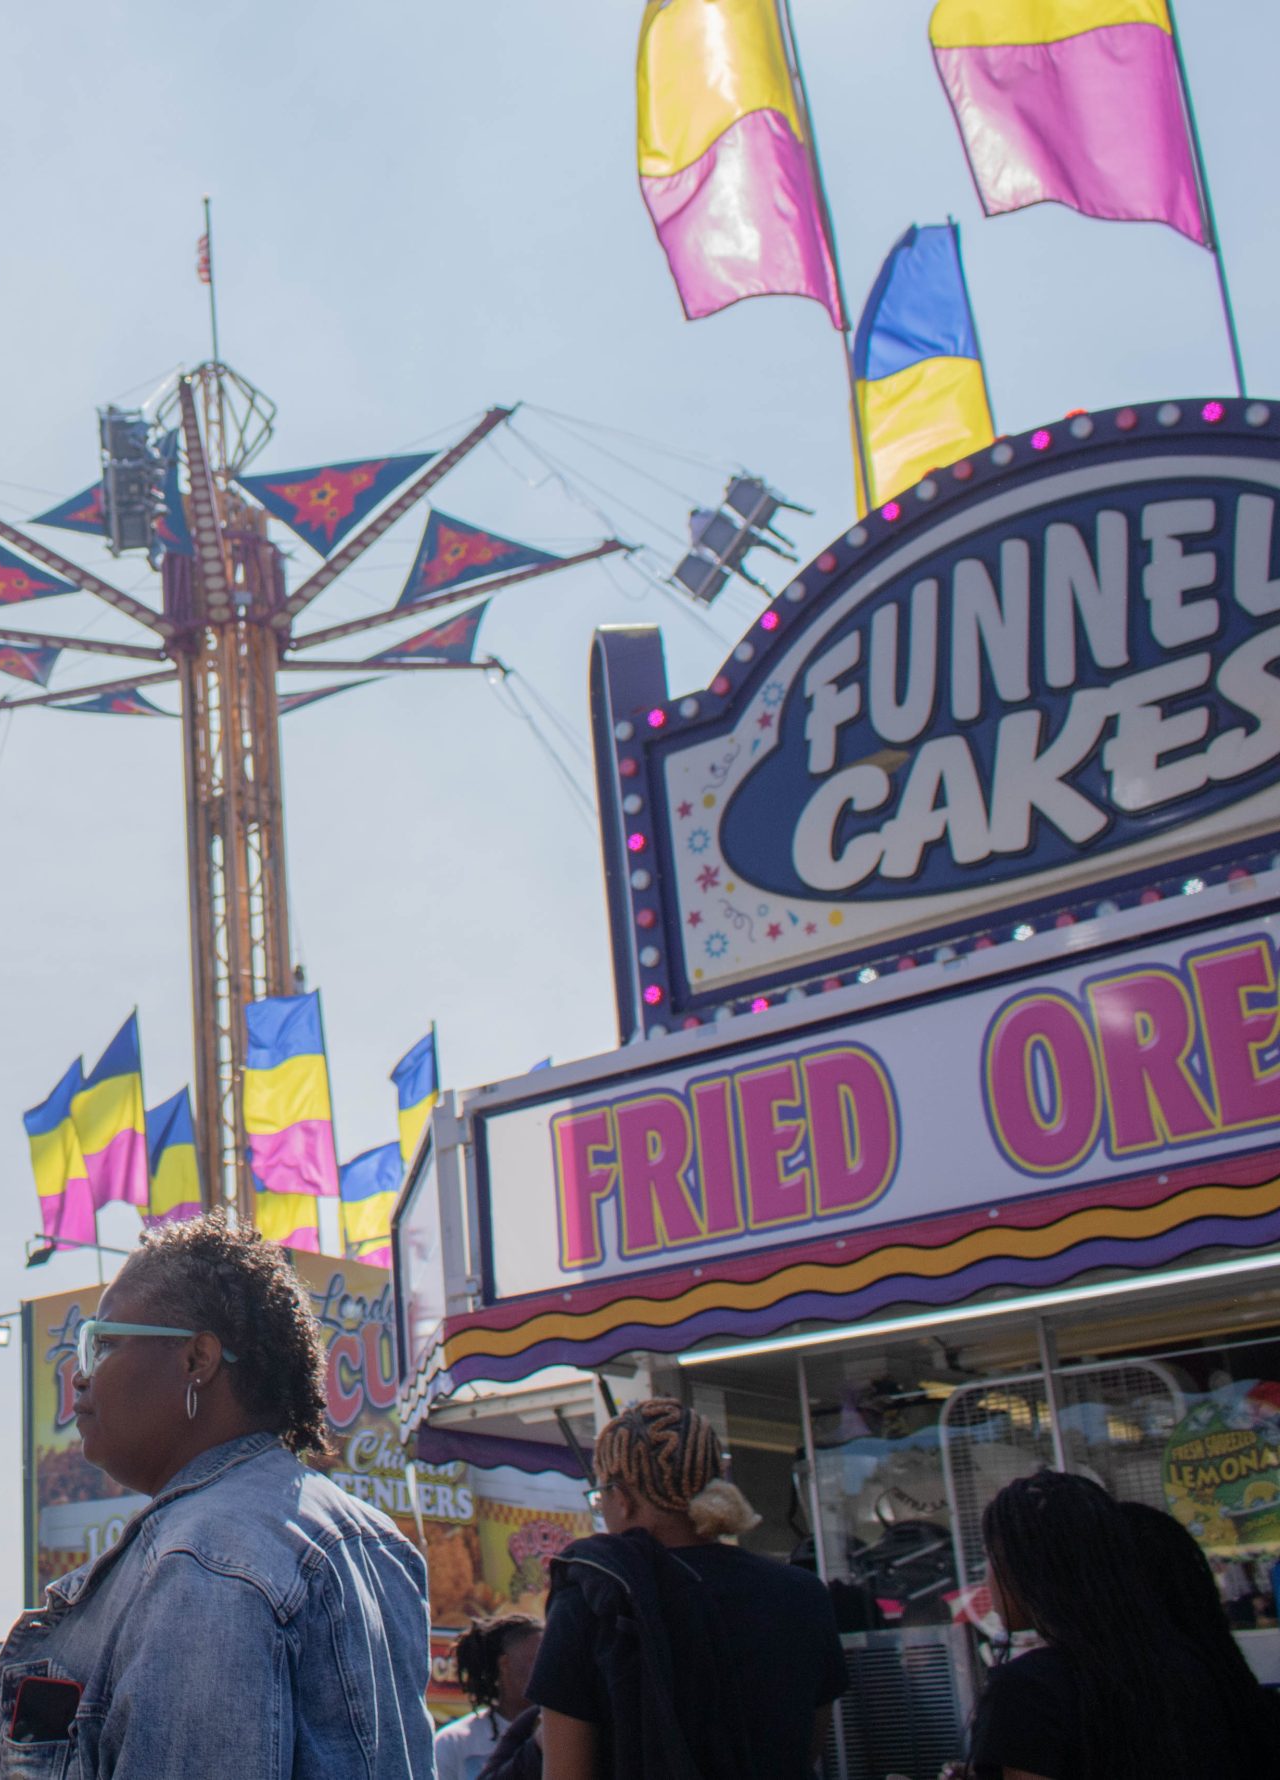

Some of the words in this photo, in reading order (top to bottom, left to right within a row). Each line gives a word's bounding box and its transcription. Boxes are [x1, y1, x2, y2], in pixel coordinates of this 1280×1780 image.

[792, 625, 1280, 891] CAKES
[804, 493, 1280, 774] FUNNEL
[551, 1042, 900, 1271] FRIED
[981, 933, 1280, 1178] ORE
[332, 1472, 474, 1519] TENDERS
[1170, 1445, 1280, 1488] LEMONA
